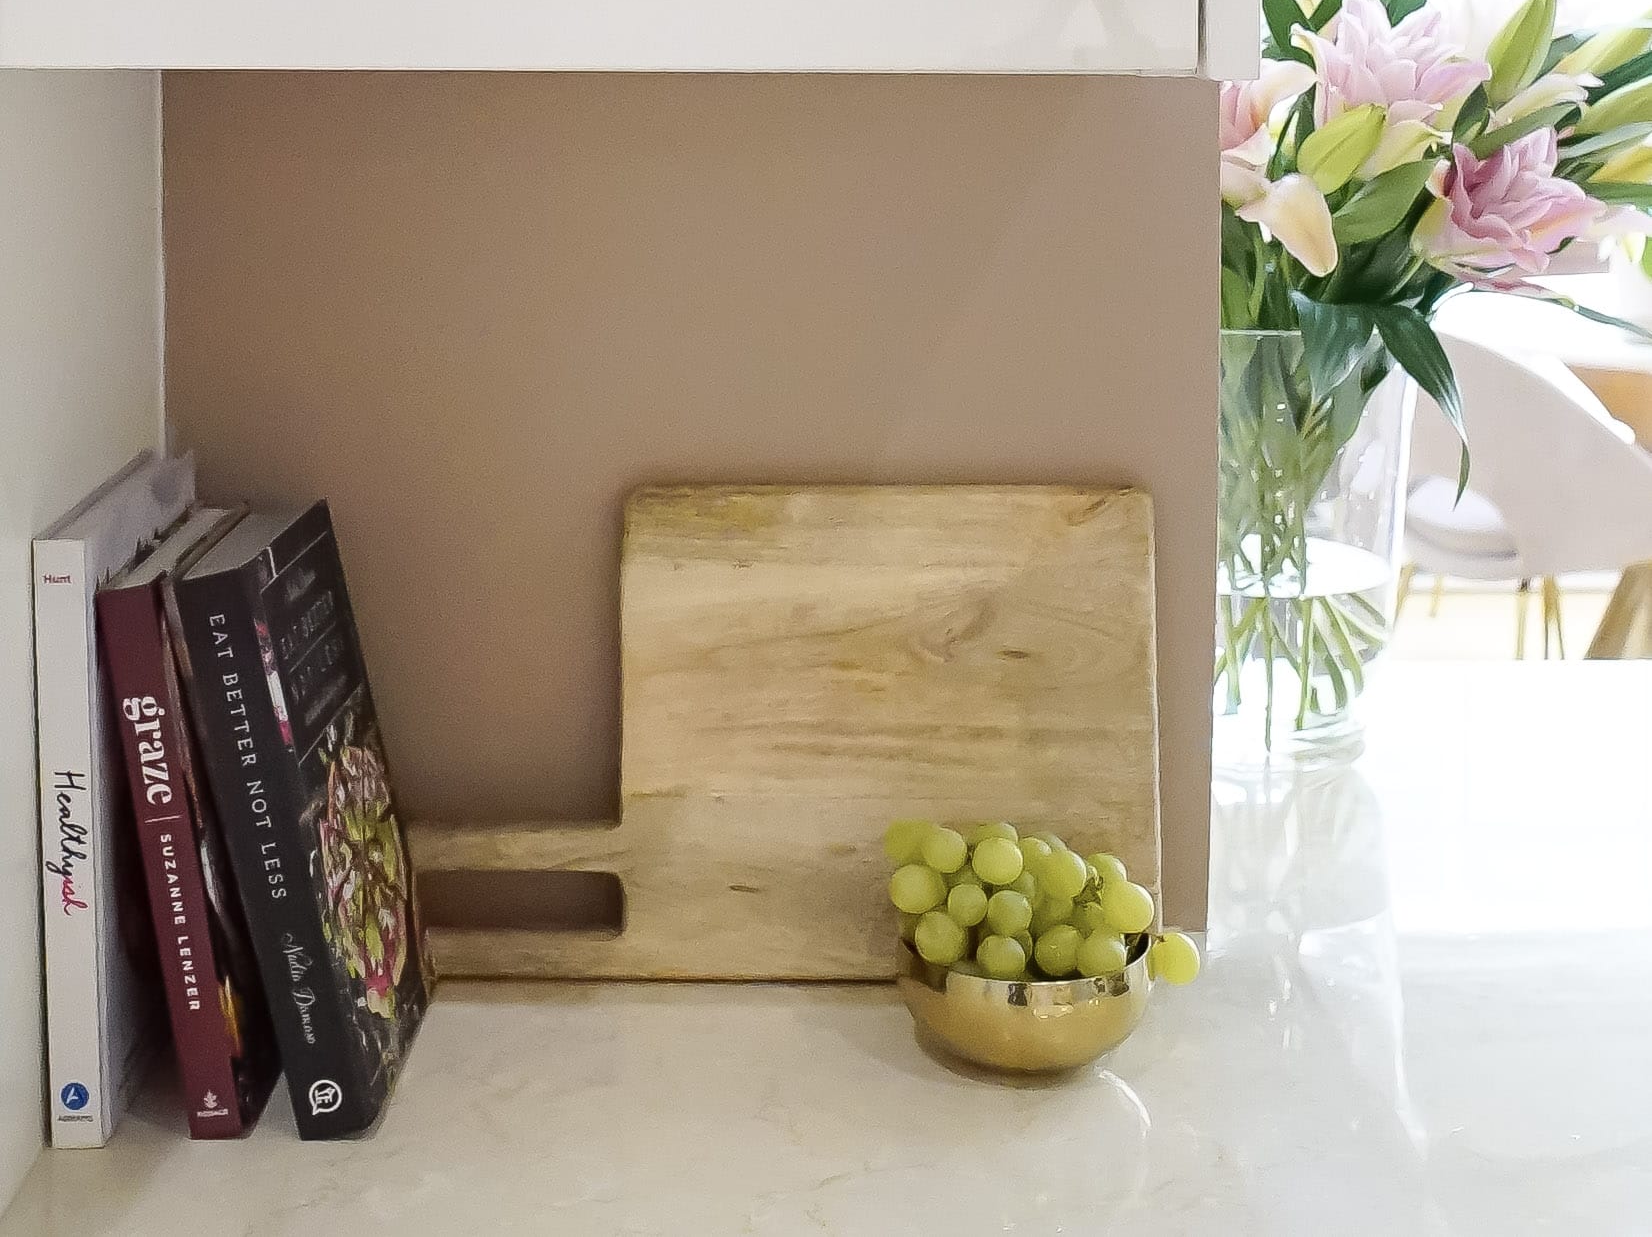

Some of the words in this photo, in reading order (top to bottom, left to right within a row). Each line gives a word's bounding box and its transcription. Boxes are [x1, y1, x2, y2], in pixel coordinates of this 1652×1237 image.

[122, 696, 173, 805] graze
[209, 614, 234, 658] EAT
[222, 672, 257, 767] BETTER
[246, 780, 272, 828] NOT
[260, 842, 287, 899] LESS
[45, 770, 89, 916] Healthyish
[160, 833, 187, 926] SUZANNE
[177, 935, 201, 1011] LENZER
